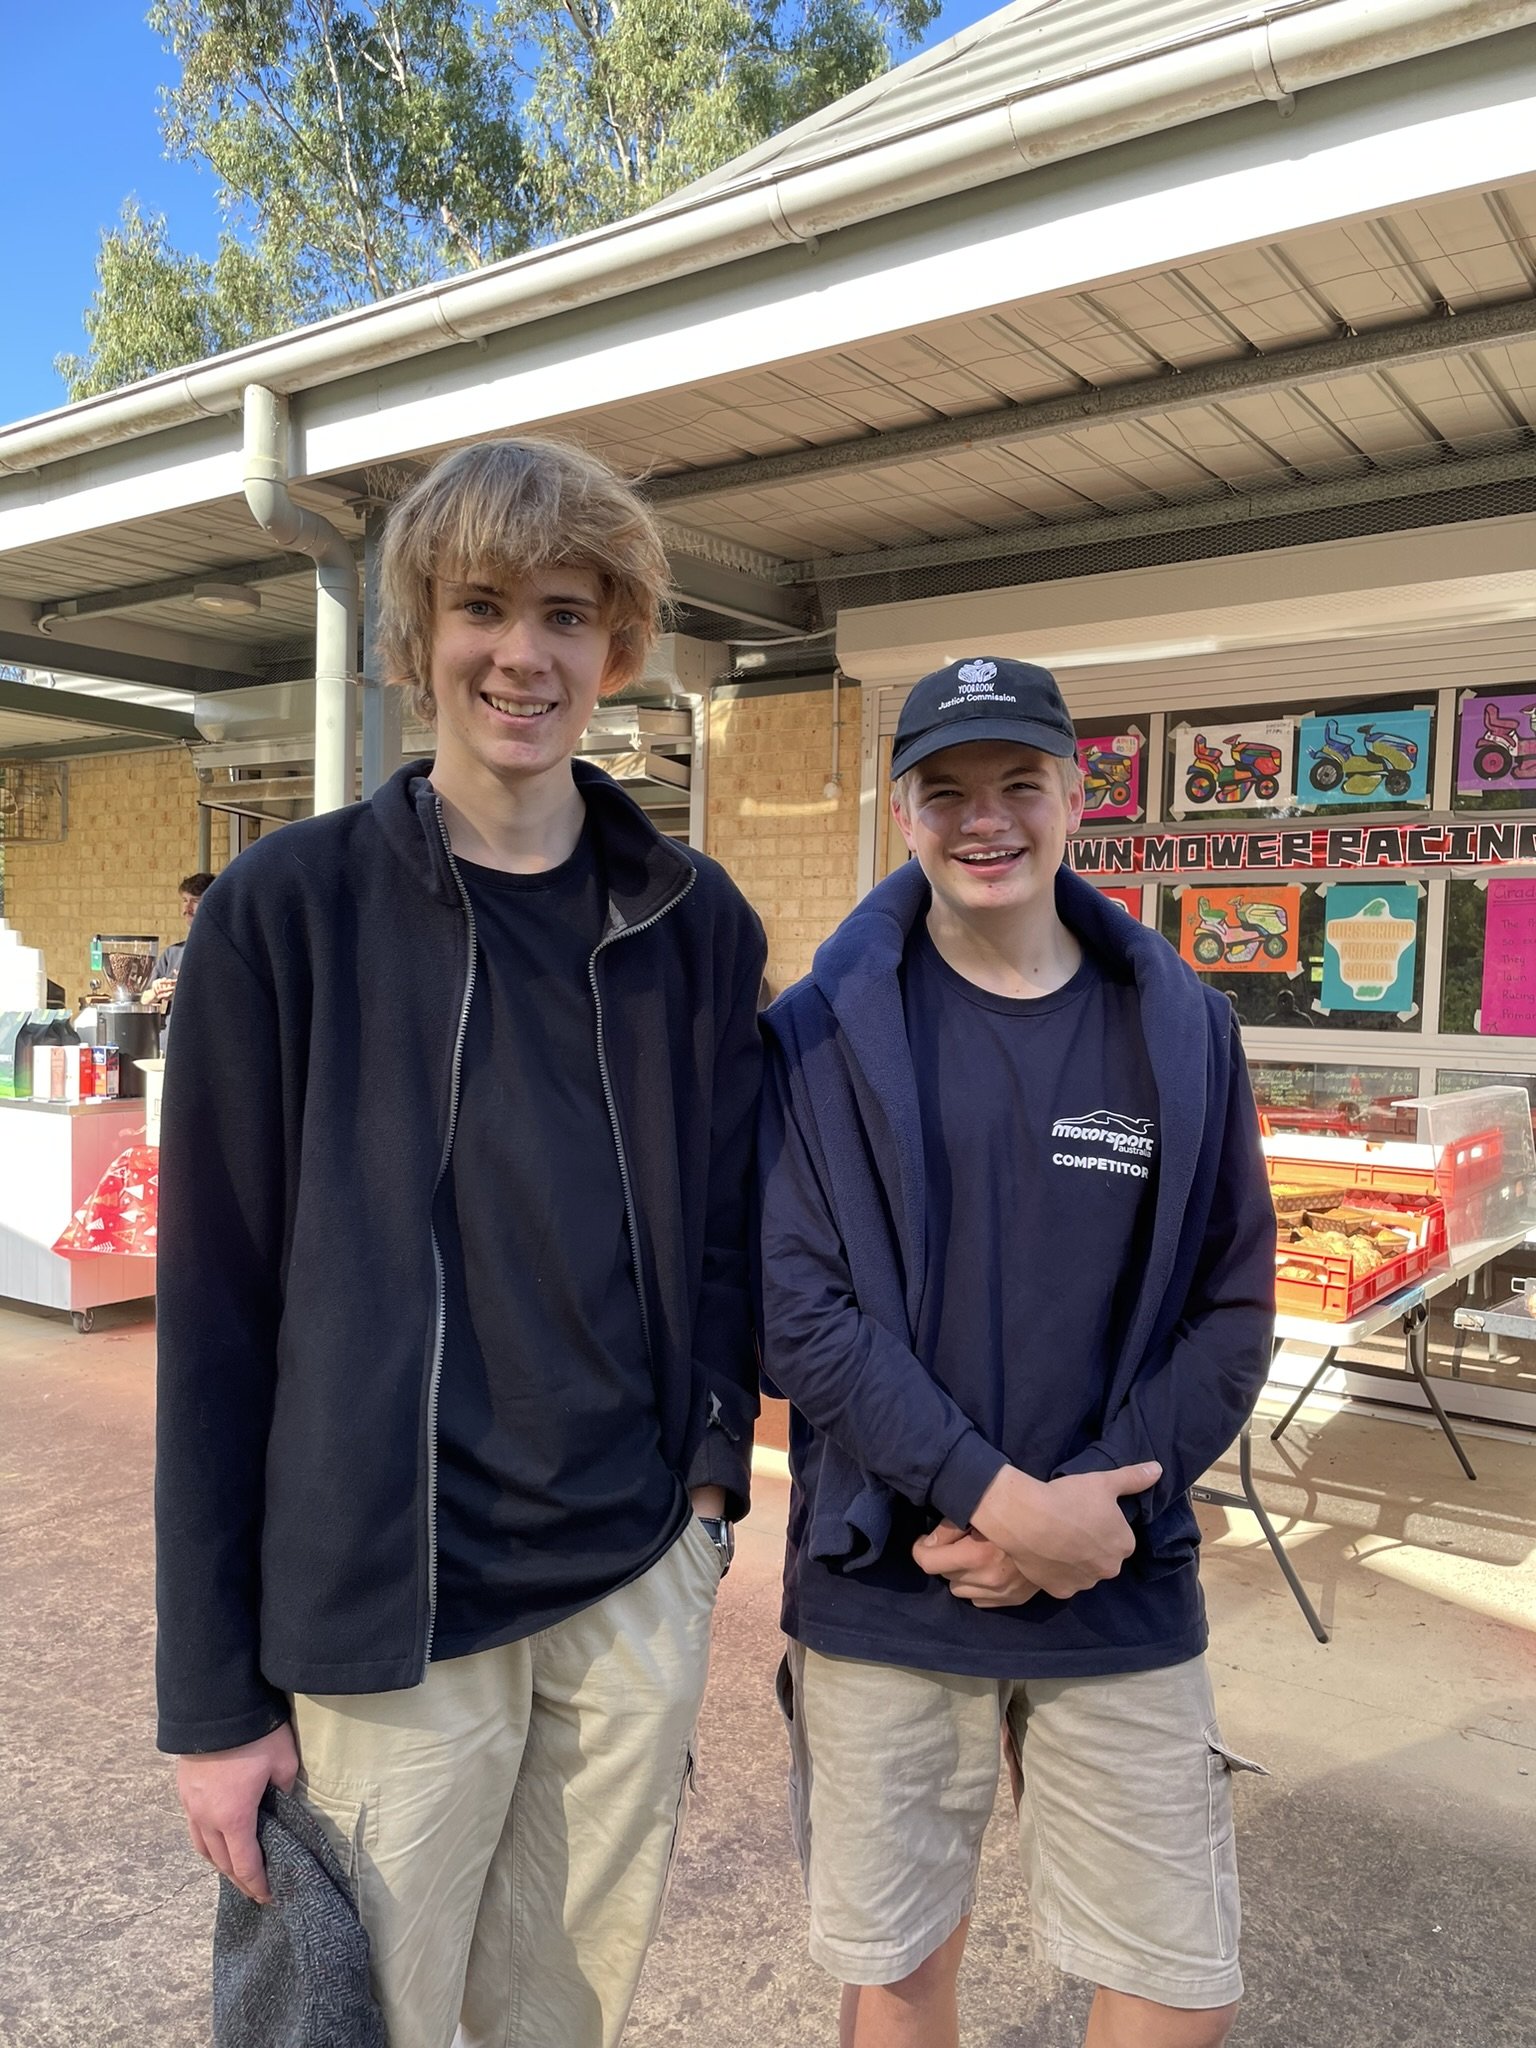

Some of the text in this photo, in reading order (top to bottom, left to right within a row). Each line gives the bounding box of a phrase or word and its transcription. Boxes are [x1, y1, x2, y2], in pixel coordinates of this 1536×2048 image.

[938, 693, 1017, 710] Justice Commission
[1143, 831, 1313, 872] MOWER
[1494, 885, 1536, 899] Grad
[1341, 942, 1399, 961] PRIMARY
[1343, 962, 1395, 982] SCHOOL
[1051, 1124, 1154, 1152] motorsport
[1118, 1145, 1152, 1158] australia
[1052, 1153, 1149, 1179] COMPETITOR
